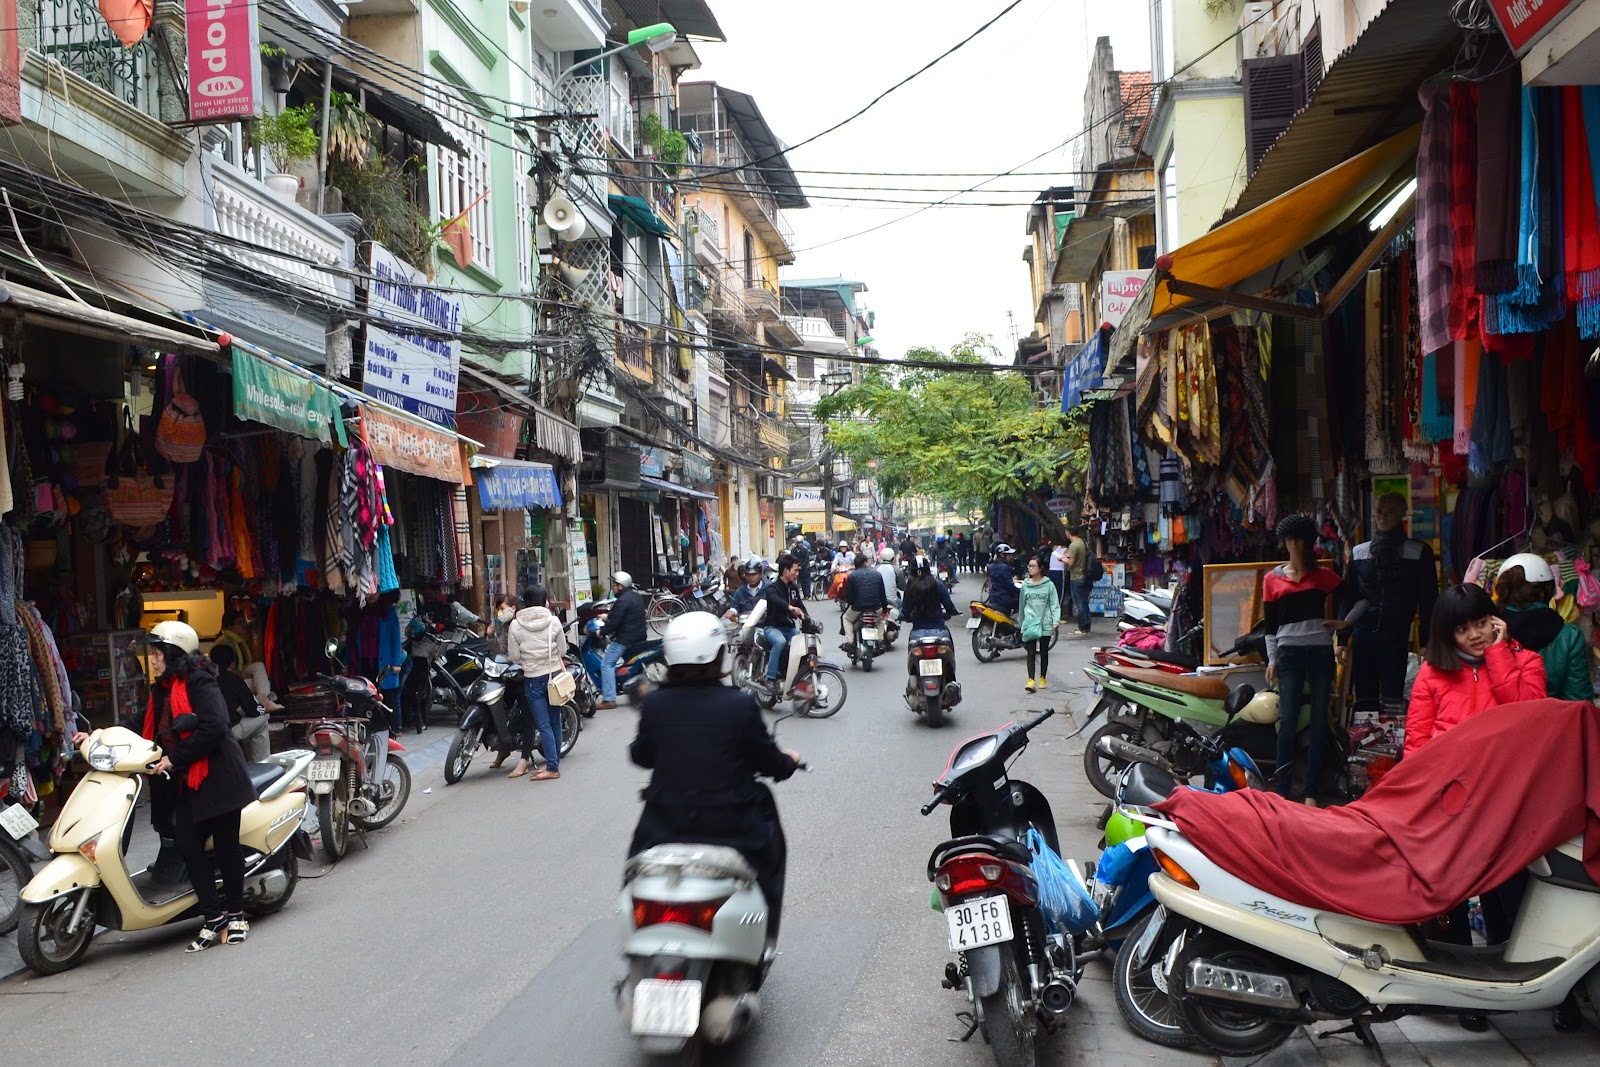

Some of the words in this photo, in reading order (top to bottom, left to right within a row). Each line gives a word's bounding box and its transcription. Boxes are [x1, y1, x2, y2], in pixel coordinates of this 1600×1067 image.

[207, 81, 236, 93] 10A
[194, 100, 212, 108] DINH
[195, 109, 207, 117] TEL:
[1111, 282, 1142, 295] Lipto
[246, 383, 286, 412] Wholesale
[376, 389, 404, 410] SALONPAS
[417, 402, 444, 423] SALONPAS
[311, 770, 335, 779] 9640
[954, 901, 999, 927] 30-F6
[959, 921, 1003, 946] 4138
